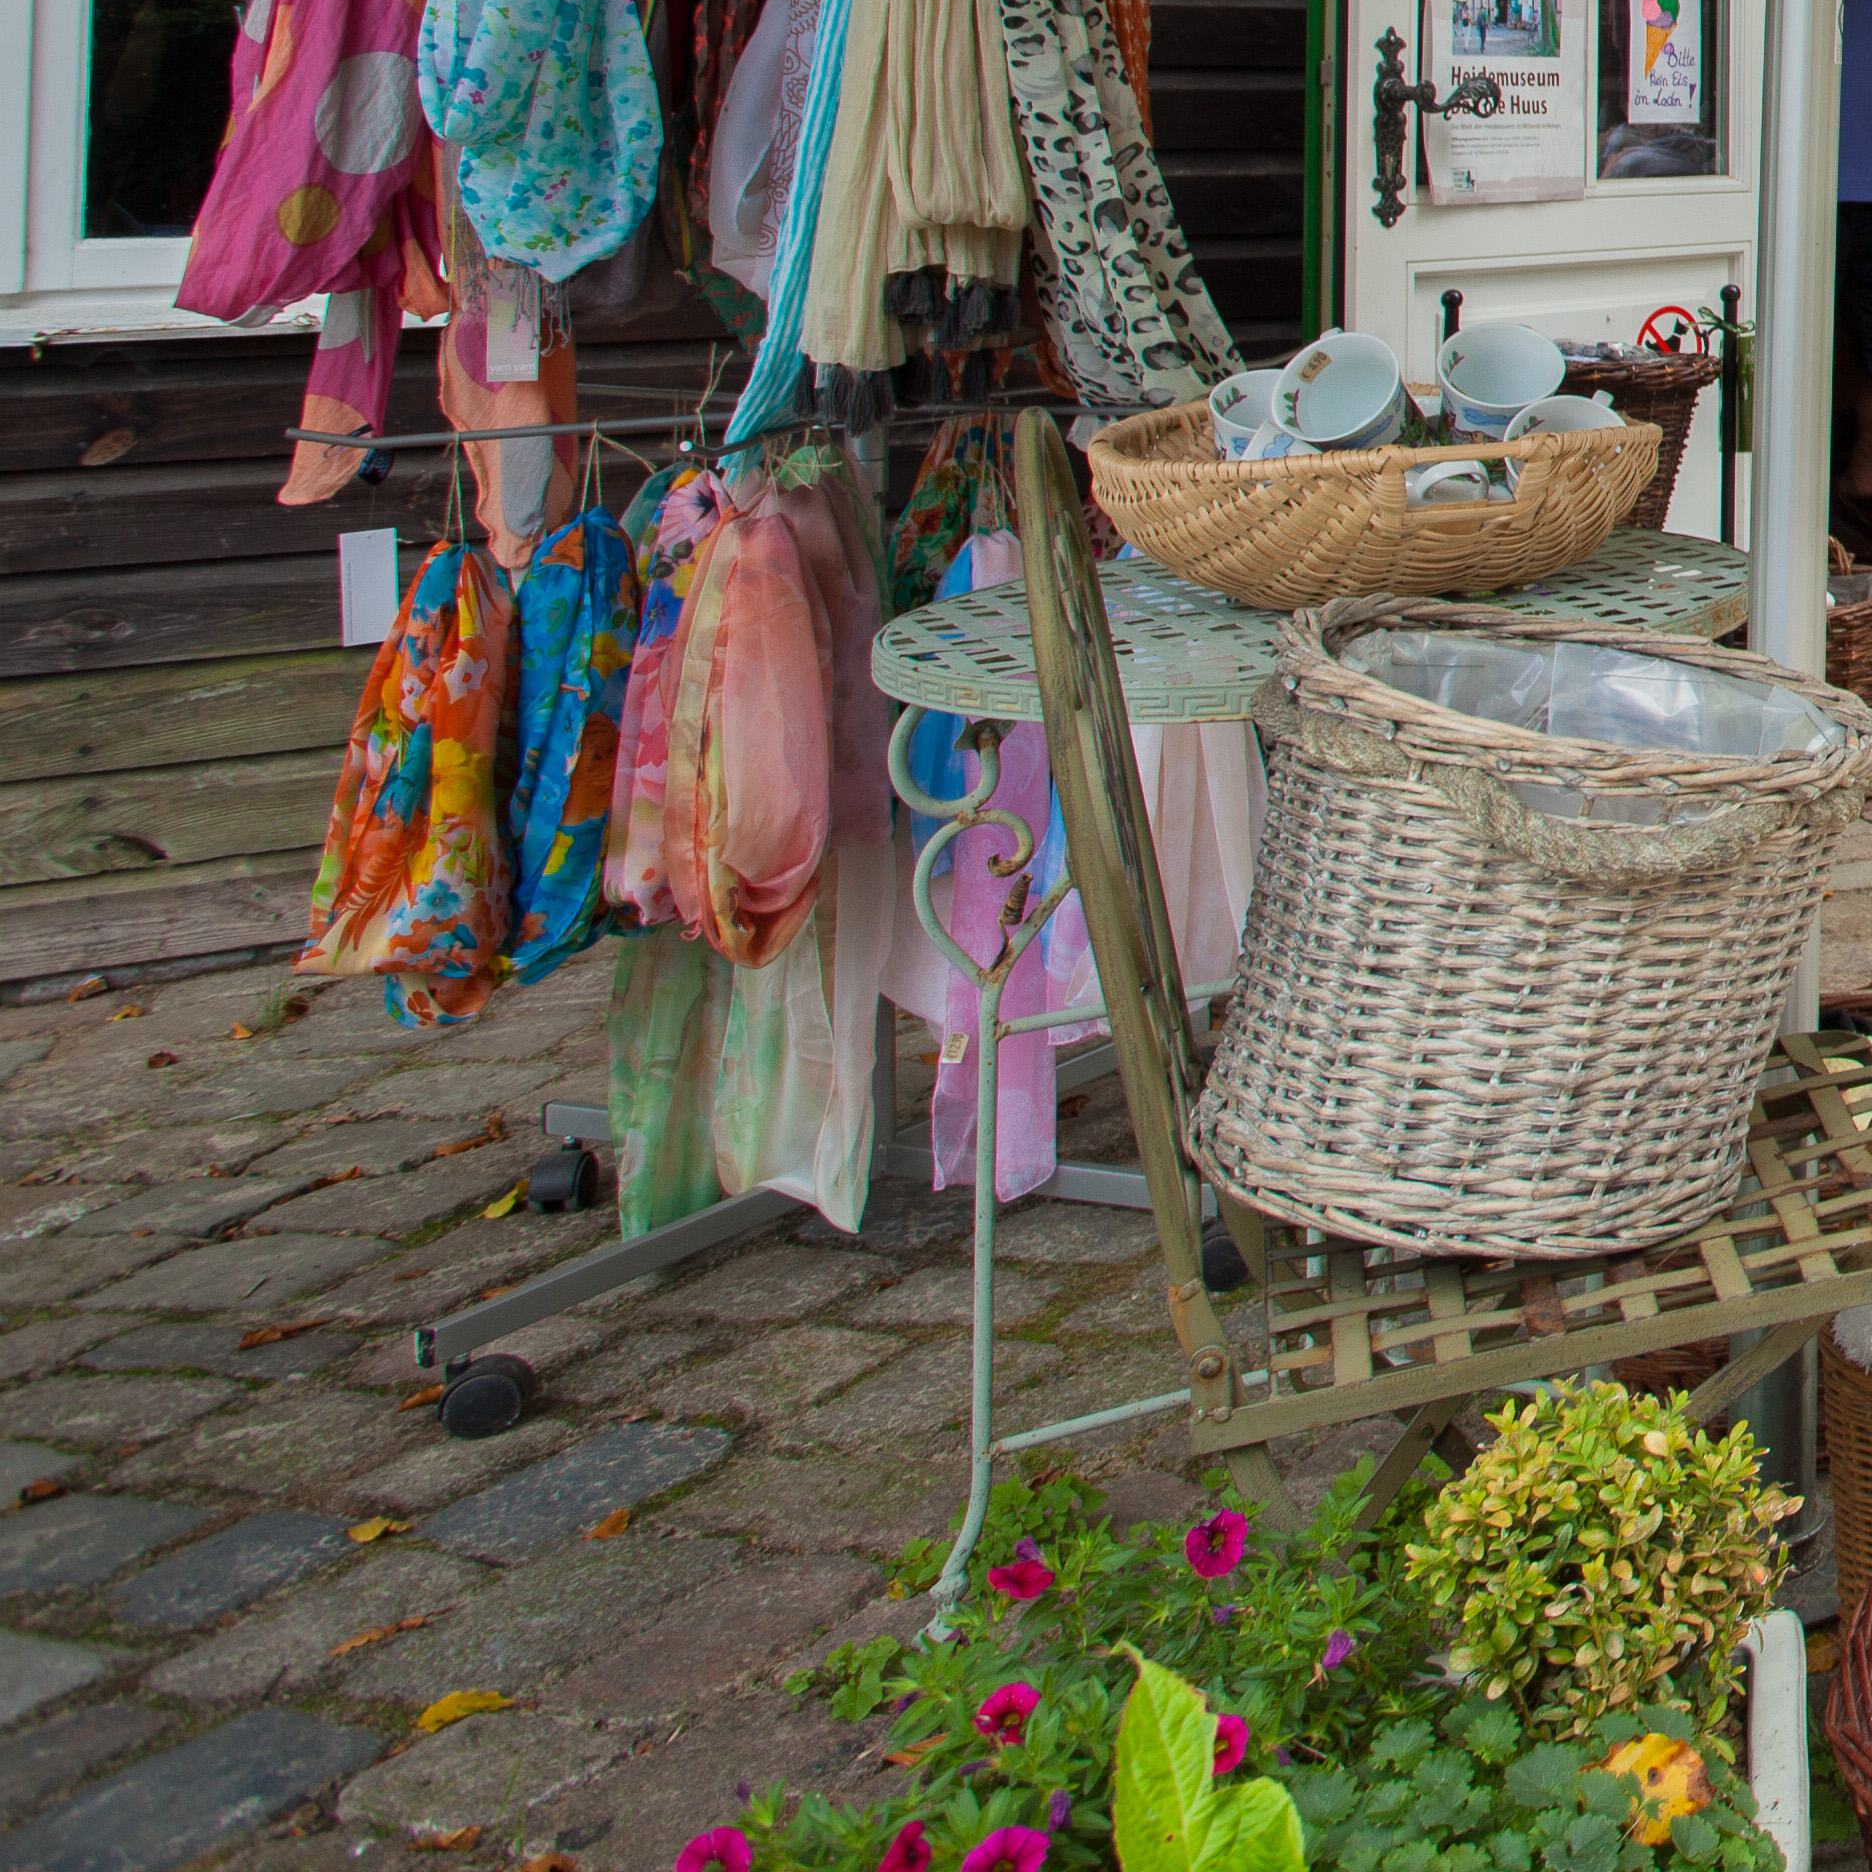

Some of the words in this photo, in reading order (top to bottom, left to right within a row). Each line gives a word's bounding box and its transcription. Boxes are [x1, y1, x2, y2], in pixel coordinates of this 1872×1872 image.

[1662, 42, 1696, 68] Bitte
[1672, 70, 1688, 87] Eis
[1510, 94, 1548, 115] Huus
